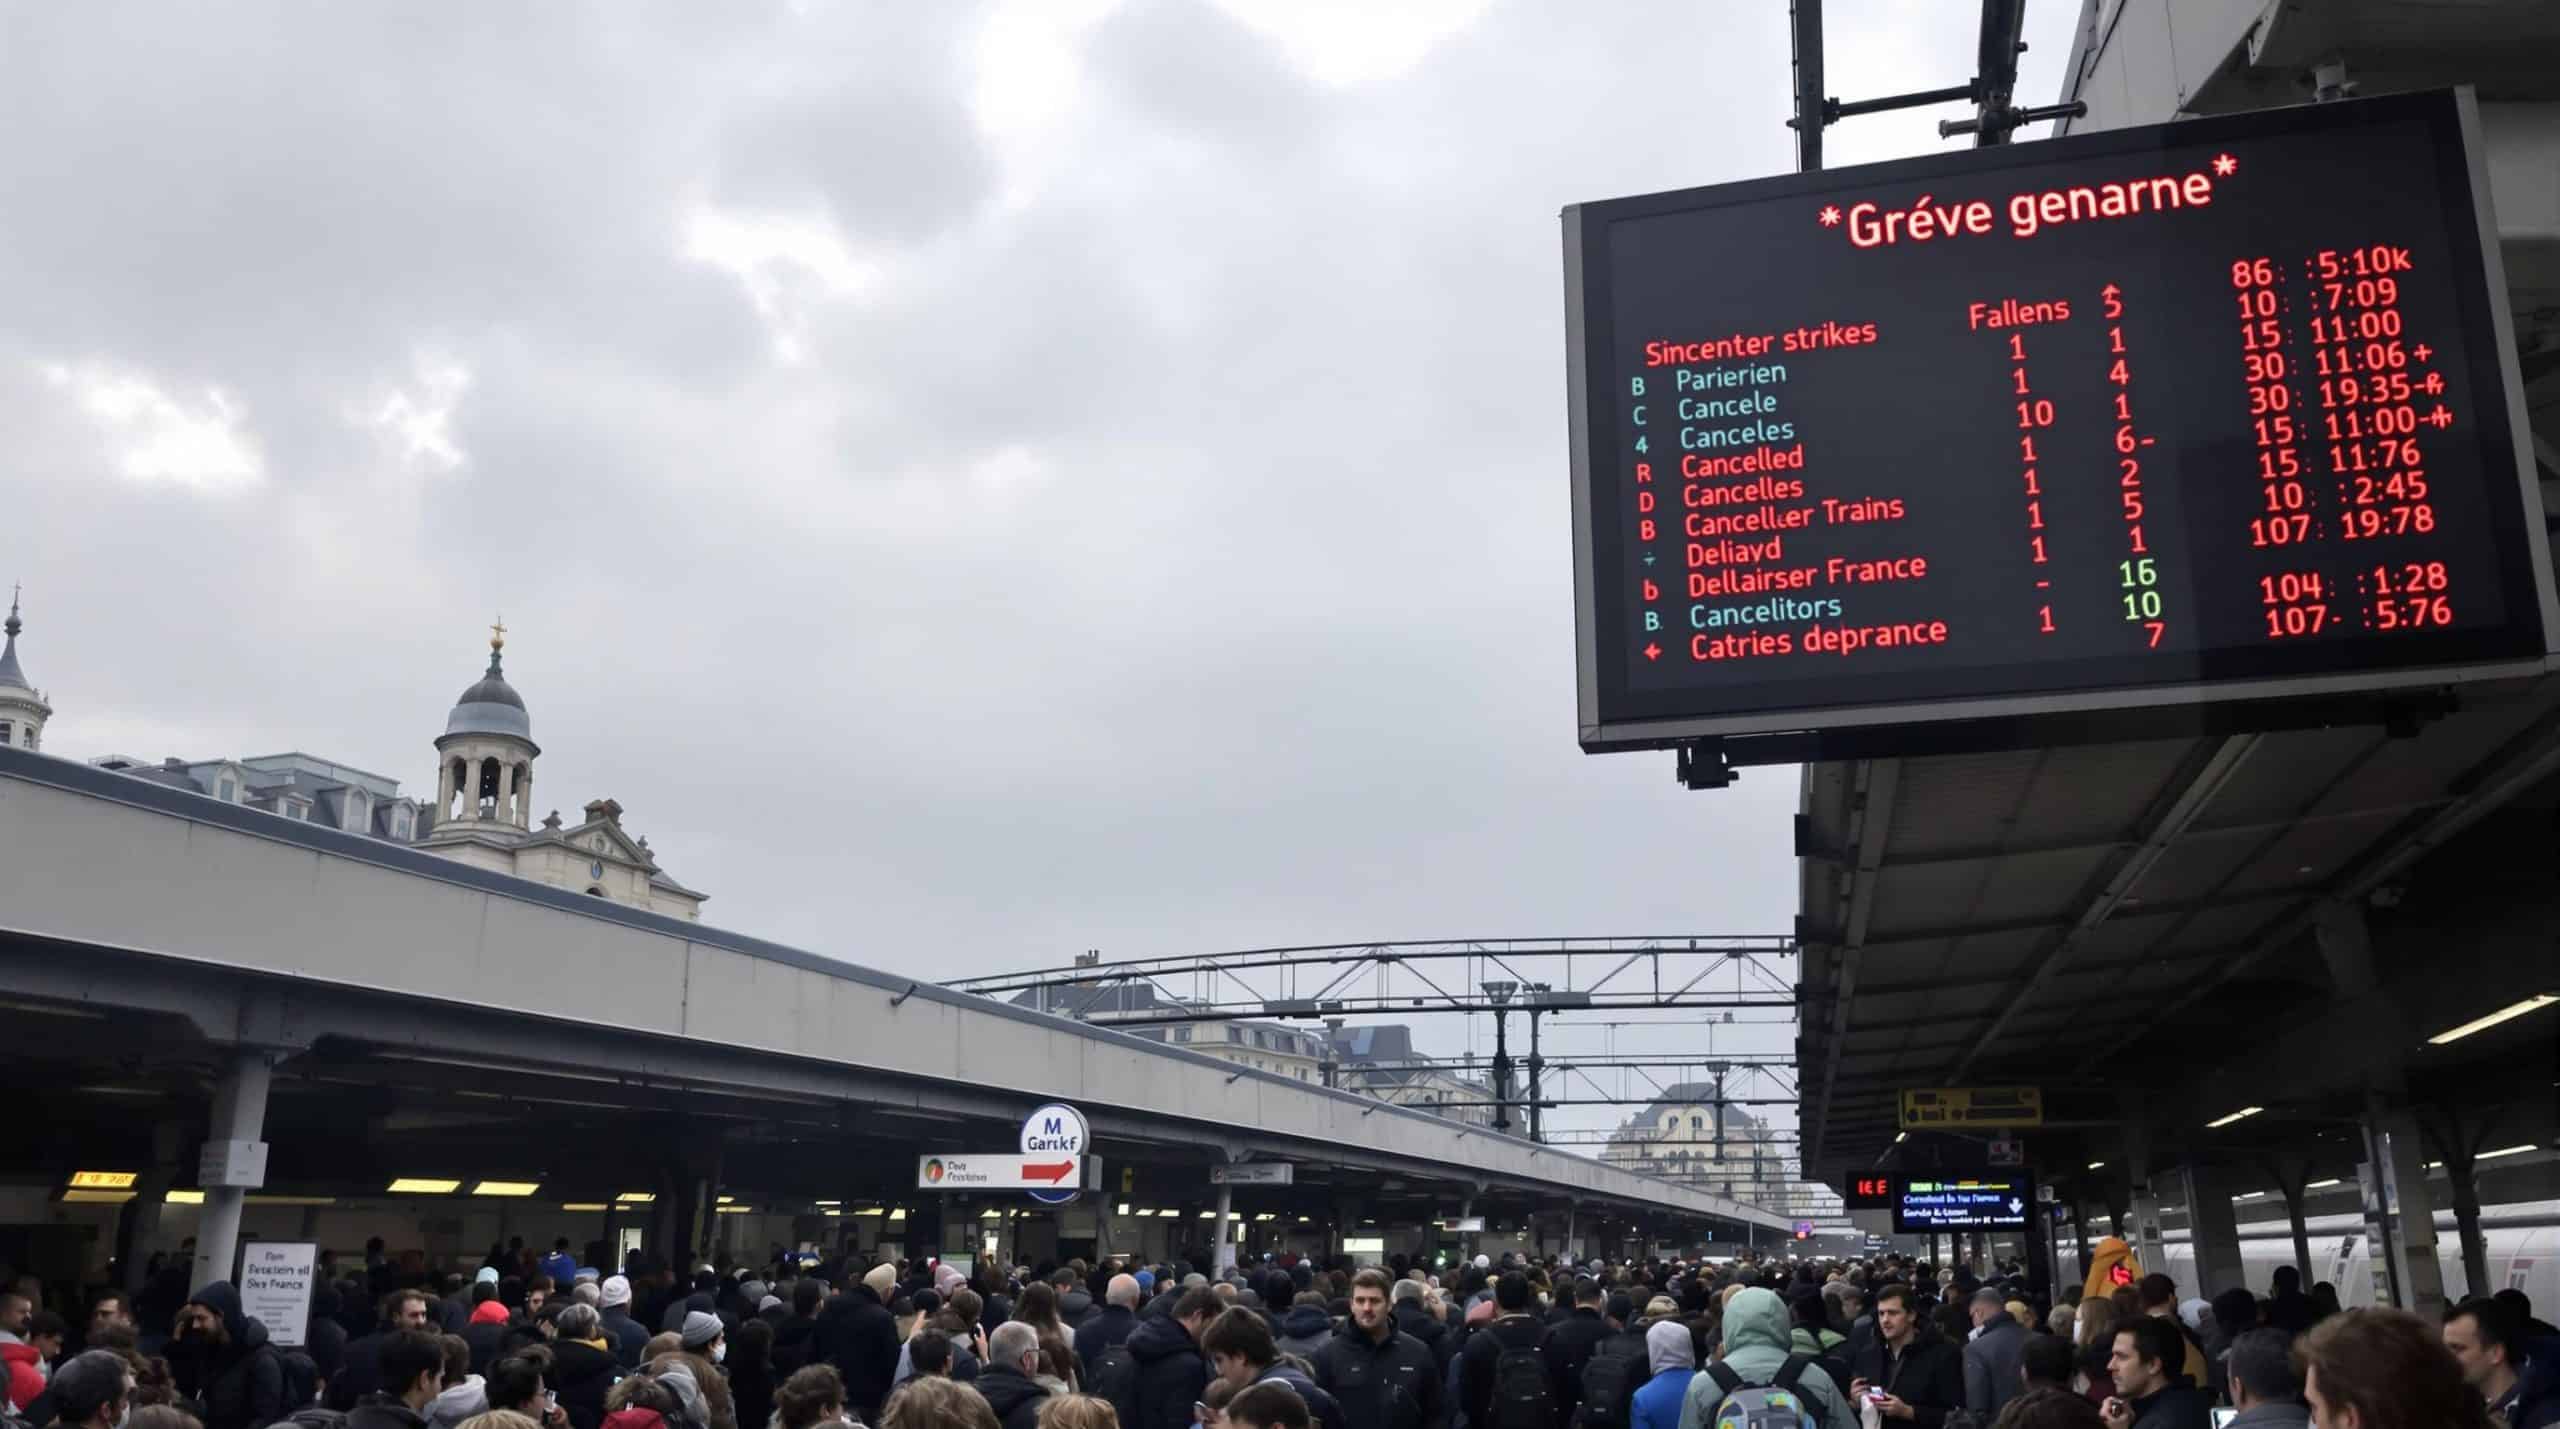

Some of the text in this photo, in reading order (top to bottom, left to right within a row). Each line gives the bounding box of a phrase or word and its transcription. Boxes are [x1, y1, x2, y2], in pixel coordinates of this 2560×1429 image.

[1968, 298, 2071, 330] Fallens
[2311, 308, 2401, 344] 11:00
[1645, 320, 1878, 367] Sincenter strikes
[2009, 333, 2026, 361] 1
[2109, 326, 2126, 353] 1
[1631, 362, 1787, 396] B Parierien
[2013, 367, 2030, 395] 1
[2109, 359, 2130, 386] 4
[1633, 389, 1777, 425] C Cancele
[2016, 399, 2054, 429] 10
[2115, 392, 2132, 420] 1
[1635, 419, 1795, 454] 4 Canceles
[2021, 435, 2037, 462] 1
[1636, 443, 1804, 484] R Cancelled
[2330, 437, 2421, 473] 11:76
[2023, 468, 2041, 496] 1
[2120, 458, 2141, 487] 2
[1639, 475, 1804, 513] D Cancelles
[2122, 491, 2144, 520] 5
[1640, 519, 1656, 541] B
[1821, 496, 1905, 524] Trains
[2027, 501, 2044, 529] 1
[2341, 503, 2435, 539] 19:78
[2031, 535, 2048, 563] 1
[2129, 525, 2147, 553] 1
[1643, 557, 1927, 601] b Dellairser France
[2119, 558, 2157, 588] 16
[1645, 597, 1842, 631] B Cancelitors
[2039, 605, 2056, 633] 1
[2123, 591, 2161, 620] 10
[1691, 630, 1793, 661] Catries
[1803, 621, 1947, 656] deprance
[2144, 621, 2165, 648] 7
[1044, 1117, 1061, 1134] M
